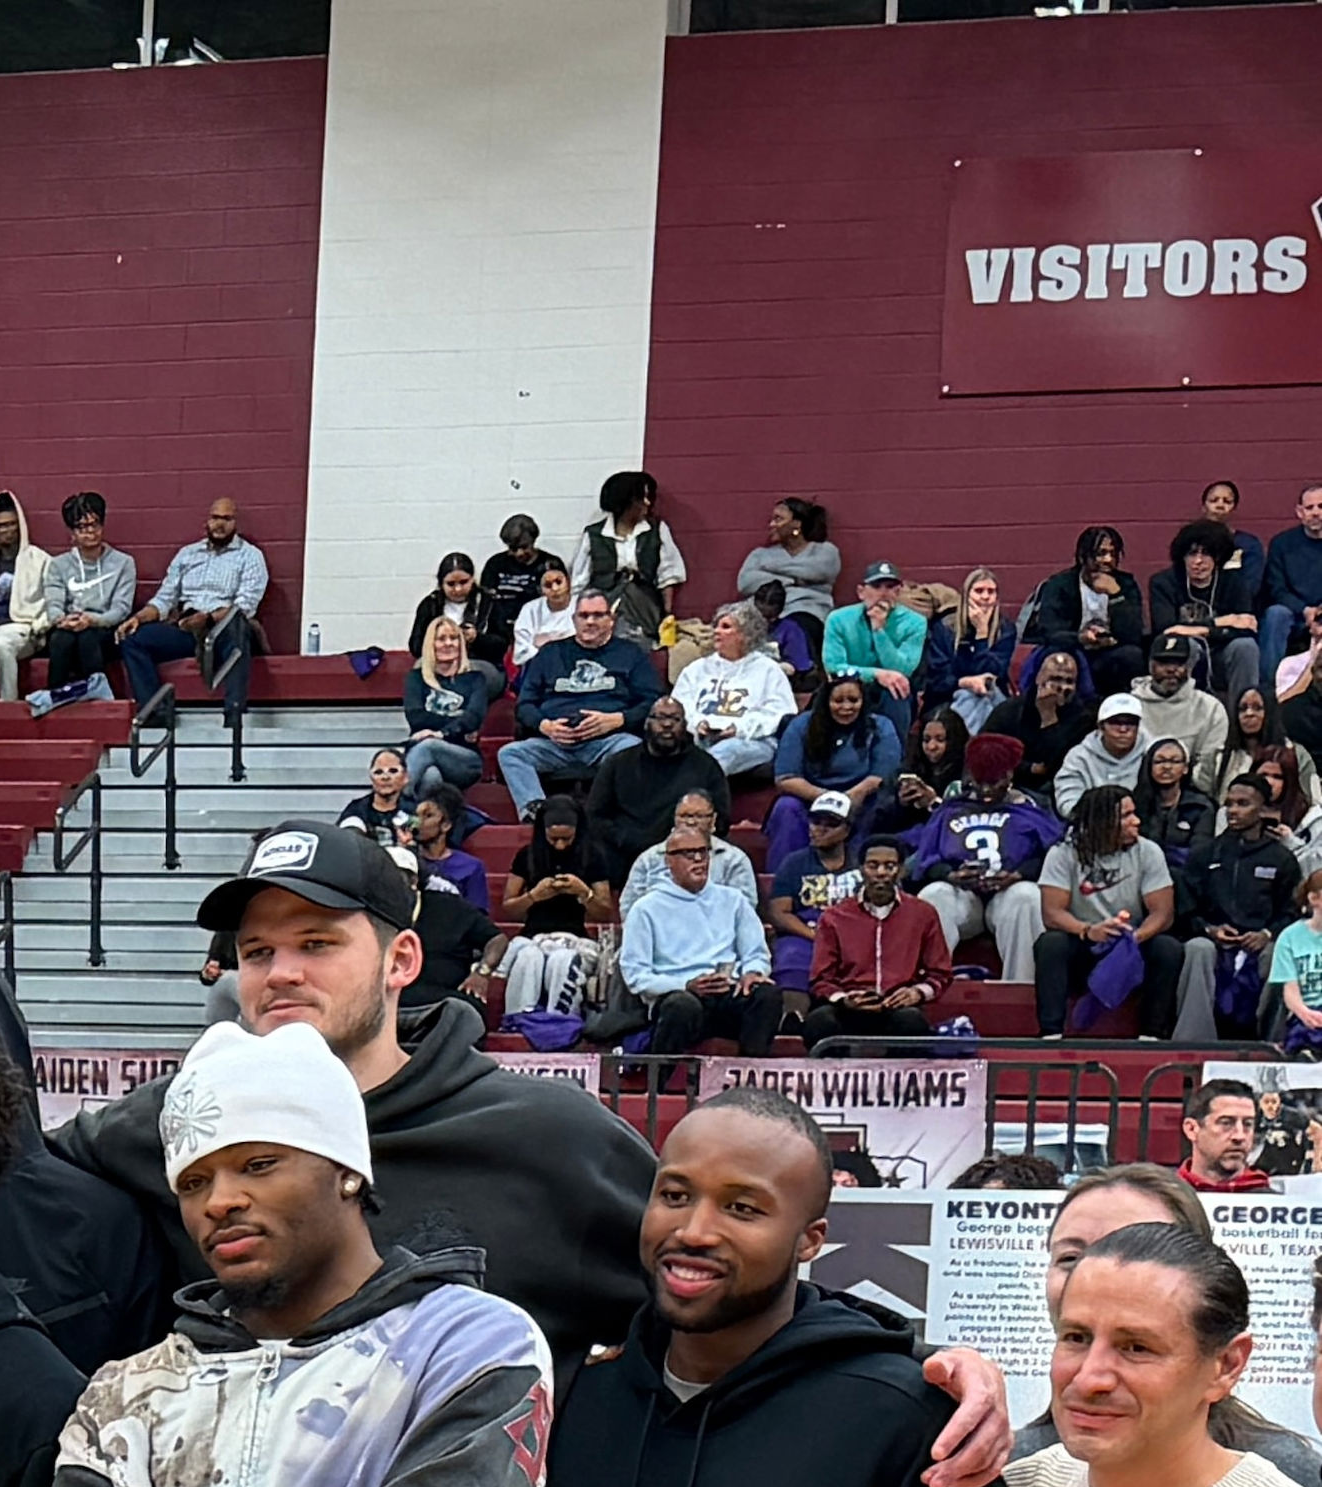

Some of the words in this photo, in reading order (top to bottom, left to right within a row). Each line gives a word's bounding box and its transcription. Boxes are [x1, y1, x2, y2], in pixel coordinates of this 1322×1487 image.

[965, 236, 1307, 304] VISITORS
[965, 830, 1002, 877] 3
[821, 1071, 968, 1108] WILLIAMS
[946, 1200, 1063, 1219] KEYONT
[1213, 1205, 1322, 1225] GEORGE
[957, 1221, 1012, 1236] George
[1221, 1227, 1299, 1239] basketball
[949, 1238, 1034, 1250] LEWISVILLE
